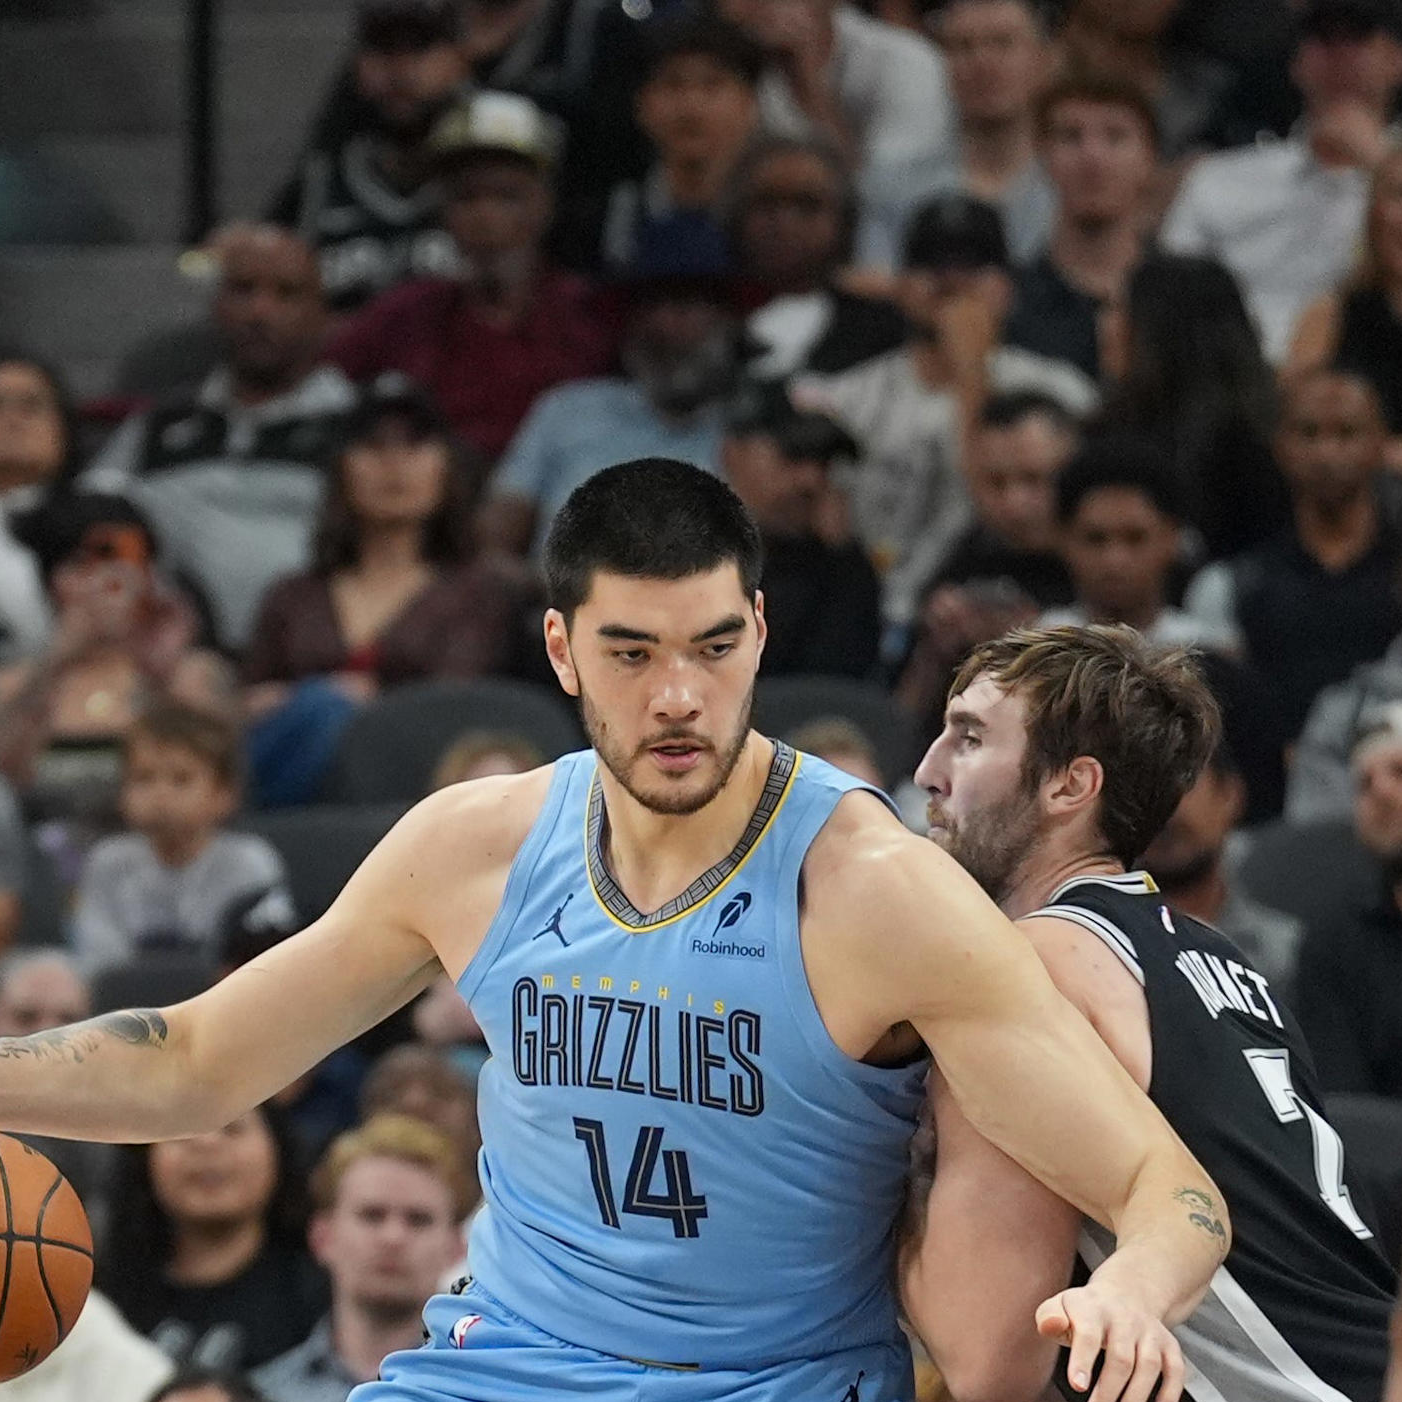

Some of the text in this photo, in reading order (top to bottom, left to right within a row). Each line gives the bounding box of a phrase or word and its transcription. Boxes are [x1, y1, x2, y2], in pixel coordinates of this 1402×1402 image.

[692, 940, 766, 958] Robinhood
[512, 976, 765, 1117] GRIZZLIES
[572, 1116, 709, 1238] 14
[1241, 1048, 1374, 1240] 7
